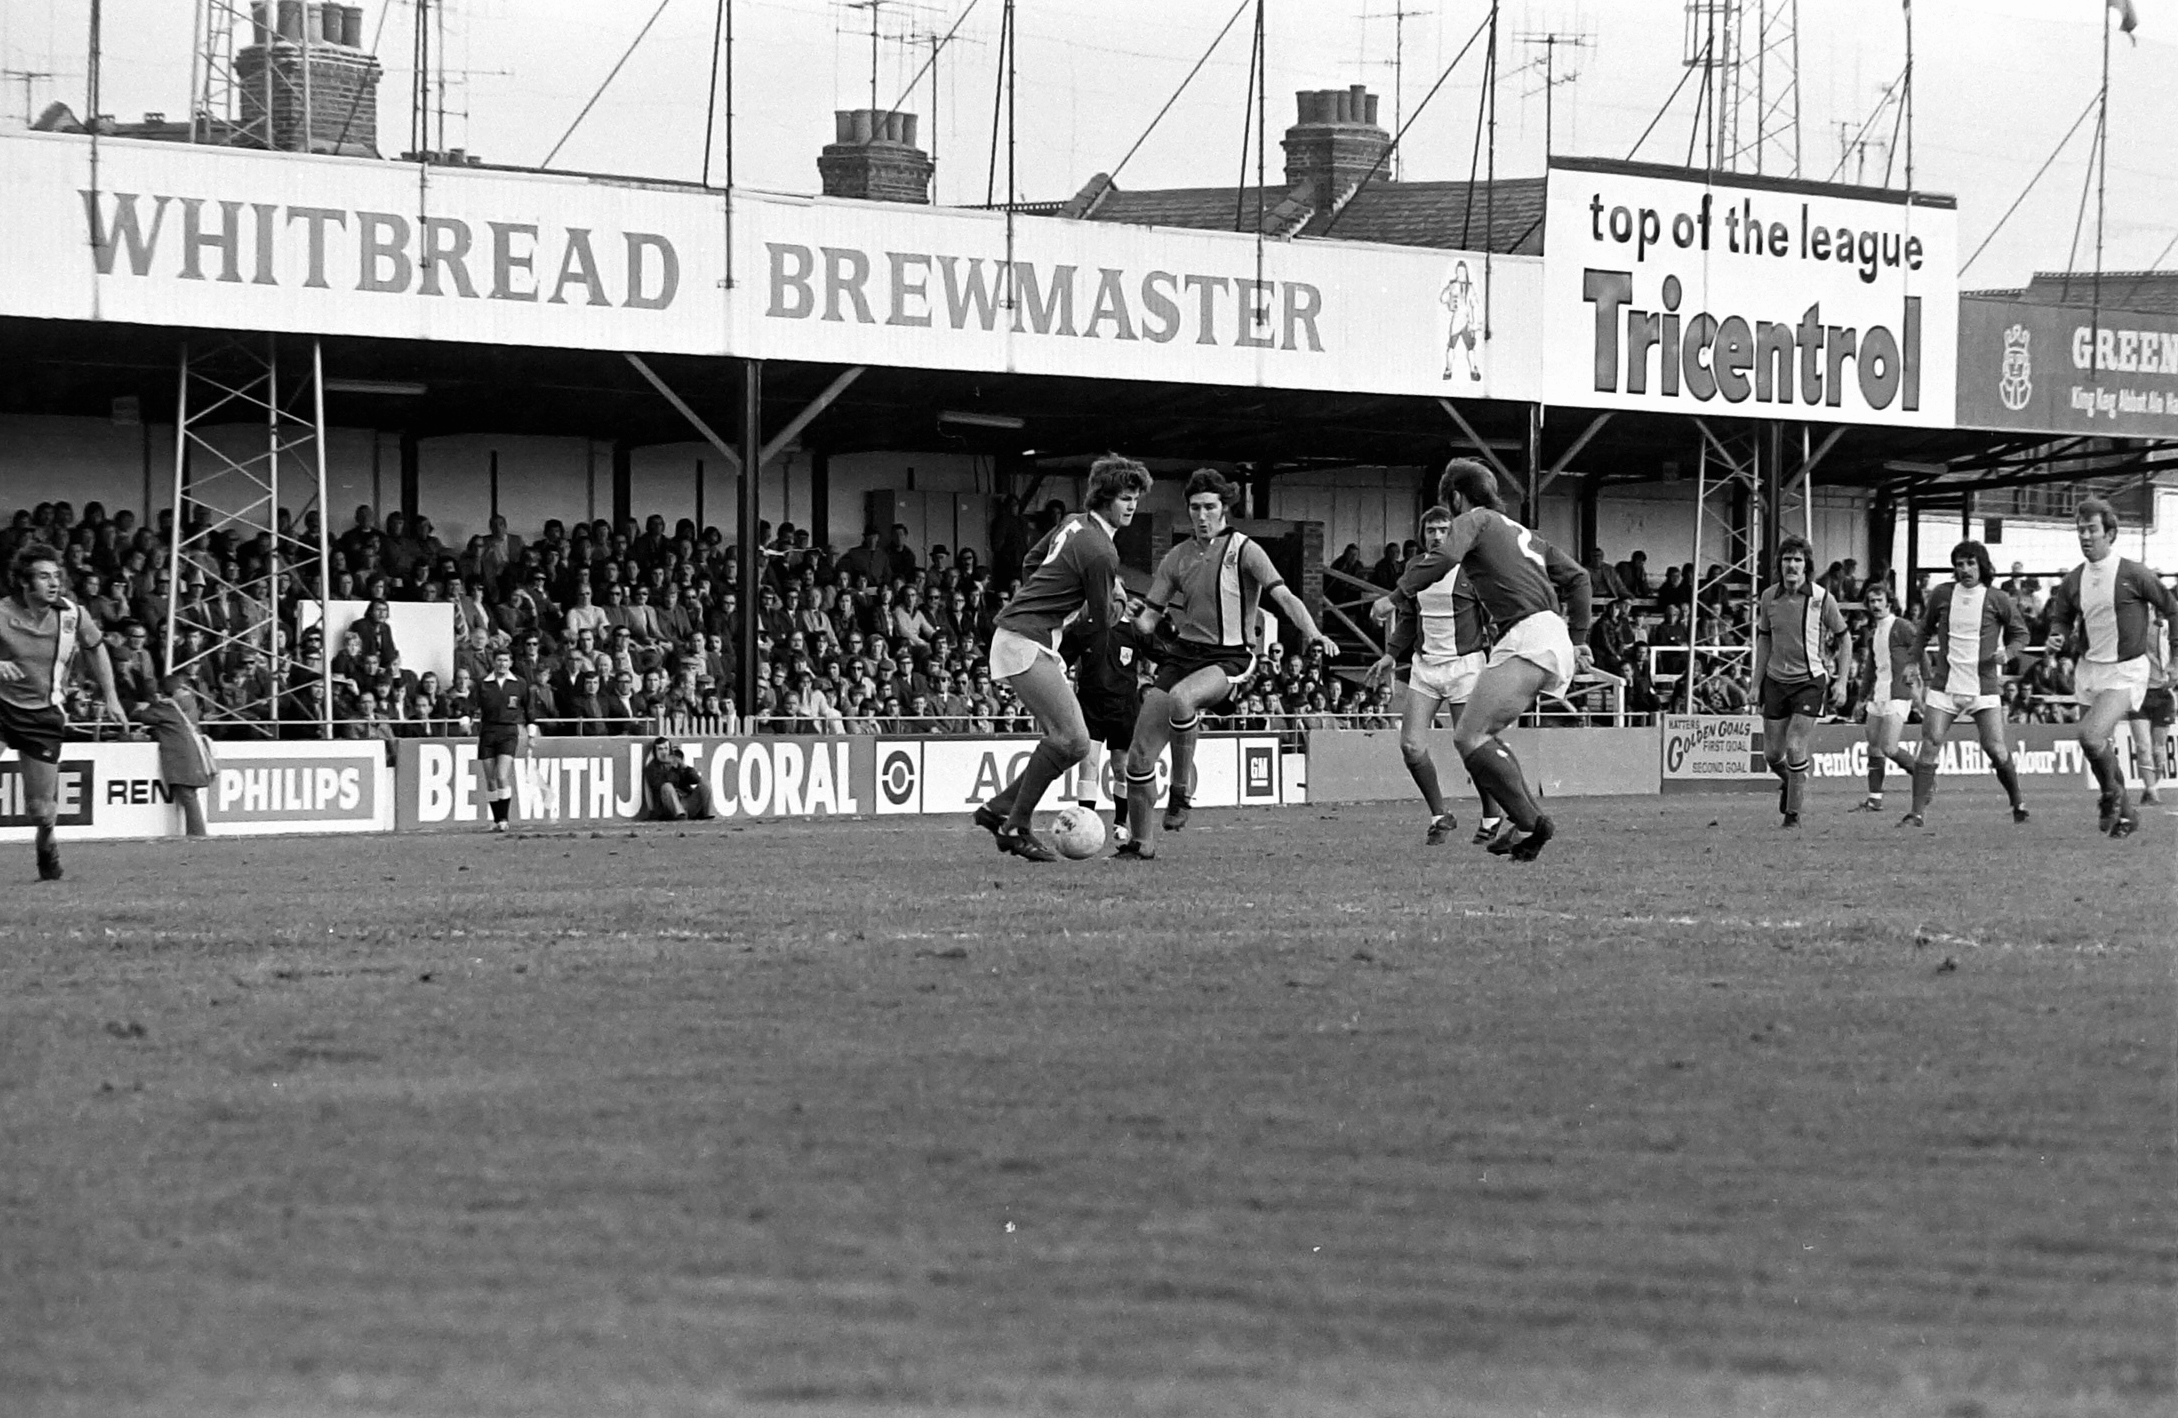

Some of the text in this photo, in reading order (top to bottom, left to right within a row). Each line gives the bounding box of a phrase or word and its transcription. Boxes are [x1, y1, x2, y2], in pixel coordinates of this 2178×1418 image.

[1589, 193, 1924, 284] top of the league
[77, 189, 1326, 352] WHITBREAD BREWMASTER
[1583, 268, 1922, 411] Tricentrol
[1501, 514, 1544, 566] 2
[1668, 720, 1700, 730] HATTERS
[1703, 741, 1747, 752] FIRST GOAL
[1251, 757, 1268, 778] GM
[1692, 762, 1748, 773] SECOND GOAL
[1812, 747, 1850, 777] rent
[2053, 740, 2084, 773] TV
[219, 767, 360, 812] PHILIPS
[418, 744, 478, 822] BE
[514, 757, 613, 819] WITH
[710, 742, 857, 816] CORAL
